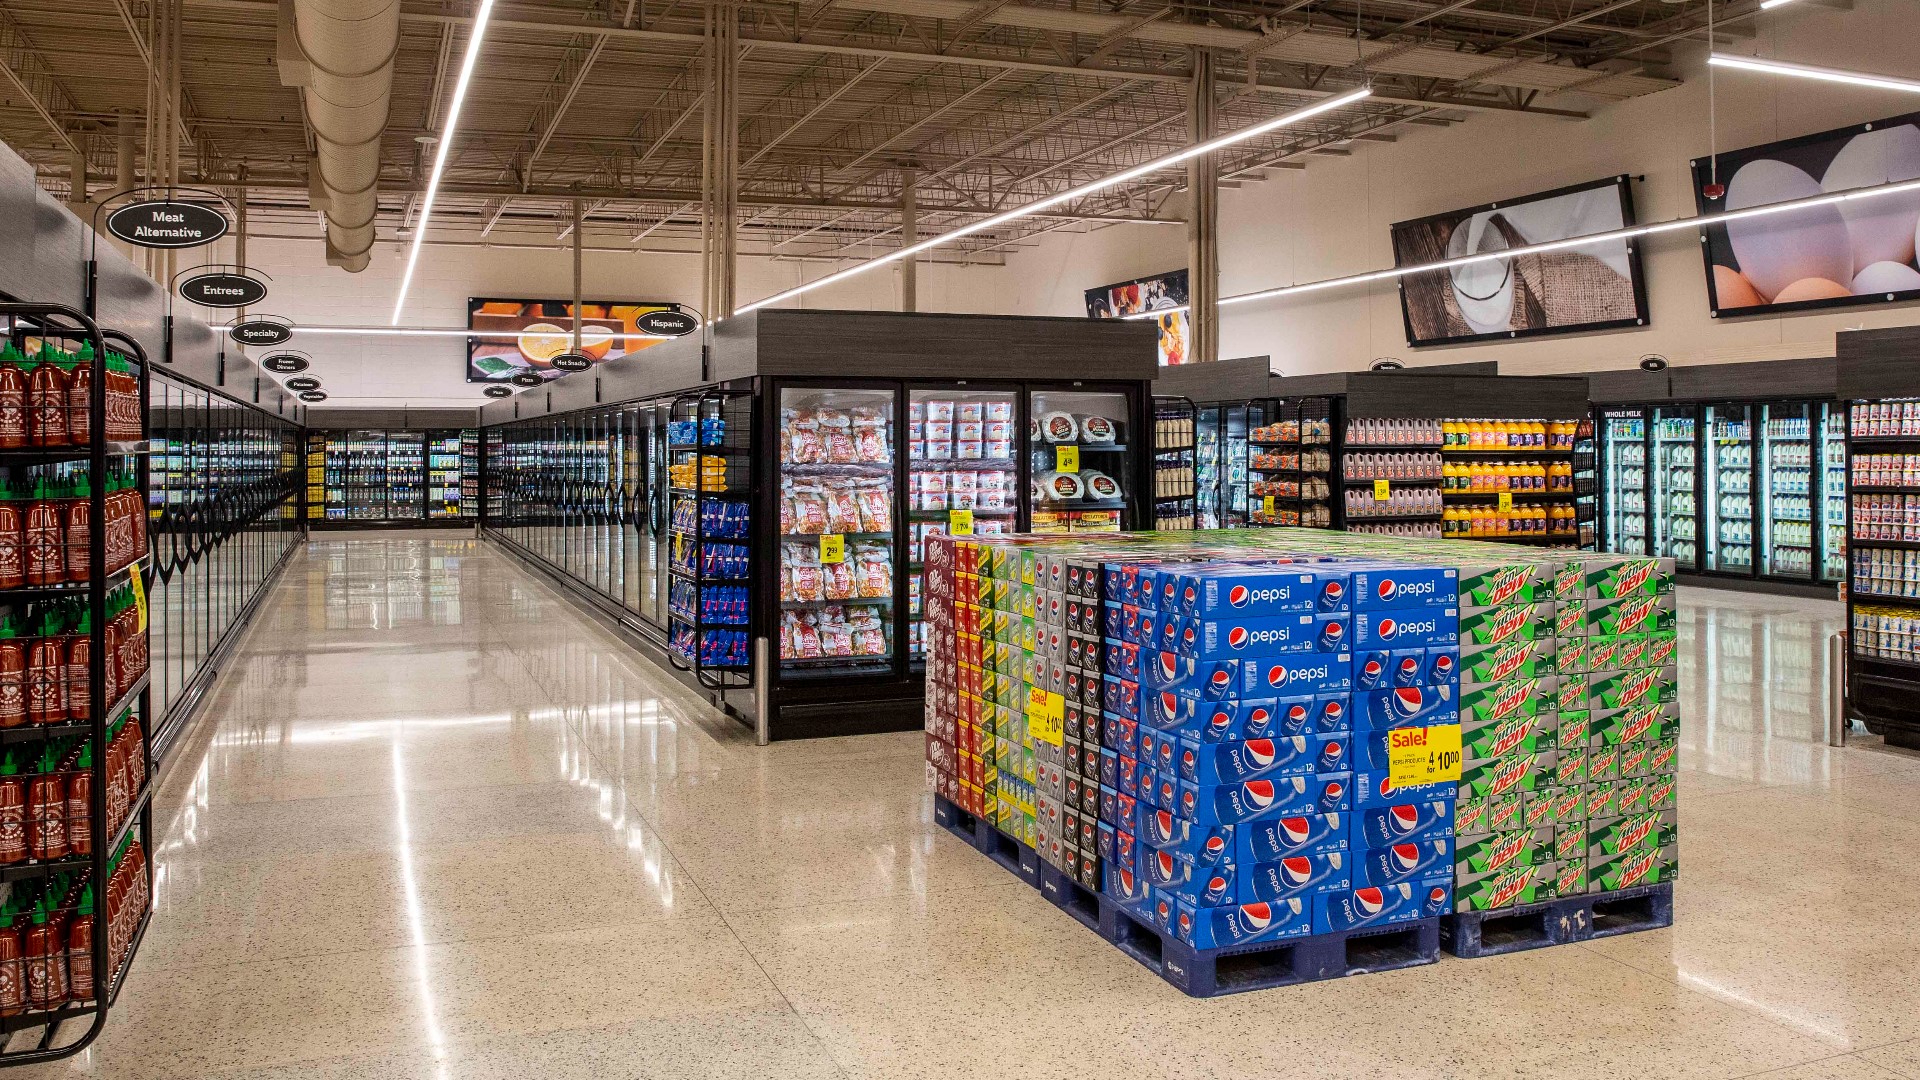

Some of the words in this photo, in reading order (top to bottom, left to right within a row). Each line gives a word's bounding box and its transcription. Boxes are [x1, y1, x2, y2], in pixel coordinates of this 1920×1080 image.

[152, 211, 185, 222] Meat
[134, 226, 202, 237] Alternative
[203, 285, 244, 296] Entrees
[650, 319, 684, 331] Hispanic
[244, 330, 279, 339] Specialty
[1251, 586, 1290, 604] pepsi
[1398, 580, 1435, 597] pepsi
[1250, 627, 1290, 645] pepsi
[1399, 619, 1435, 637] pepsi
[1290, 664, 1328, 683] pepsi
[1032, 690, 1048, 706] Sale!
[1382, 696, 1397, 722] pepsi
[1392, 728, 1428, 748] Sale!
[1230, 749, 1247, 775] pepsi
[1428, 751, 1435, 766] 4
[1426, 766, 1436, 774] for
[1230, 790, 1246, 816] pepsi
[1377, 815, 1392, 840] pepsi
[1266, 828, 1282, 853] pepsi
[1379, 854, 1393, 879] pepsi
[1268, 868, 1283, 893] pepsi
[1342, 899, 1357, 924] pepsi
[1226, 914, 1242, 939] pepsi
